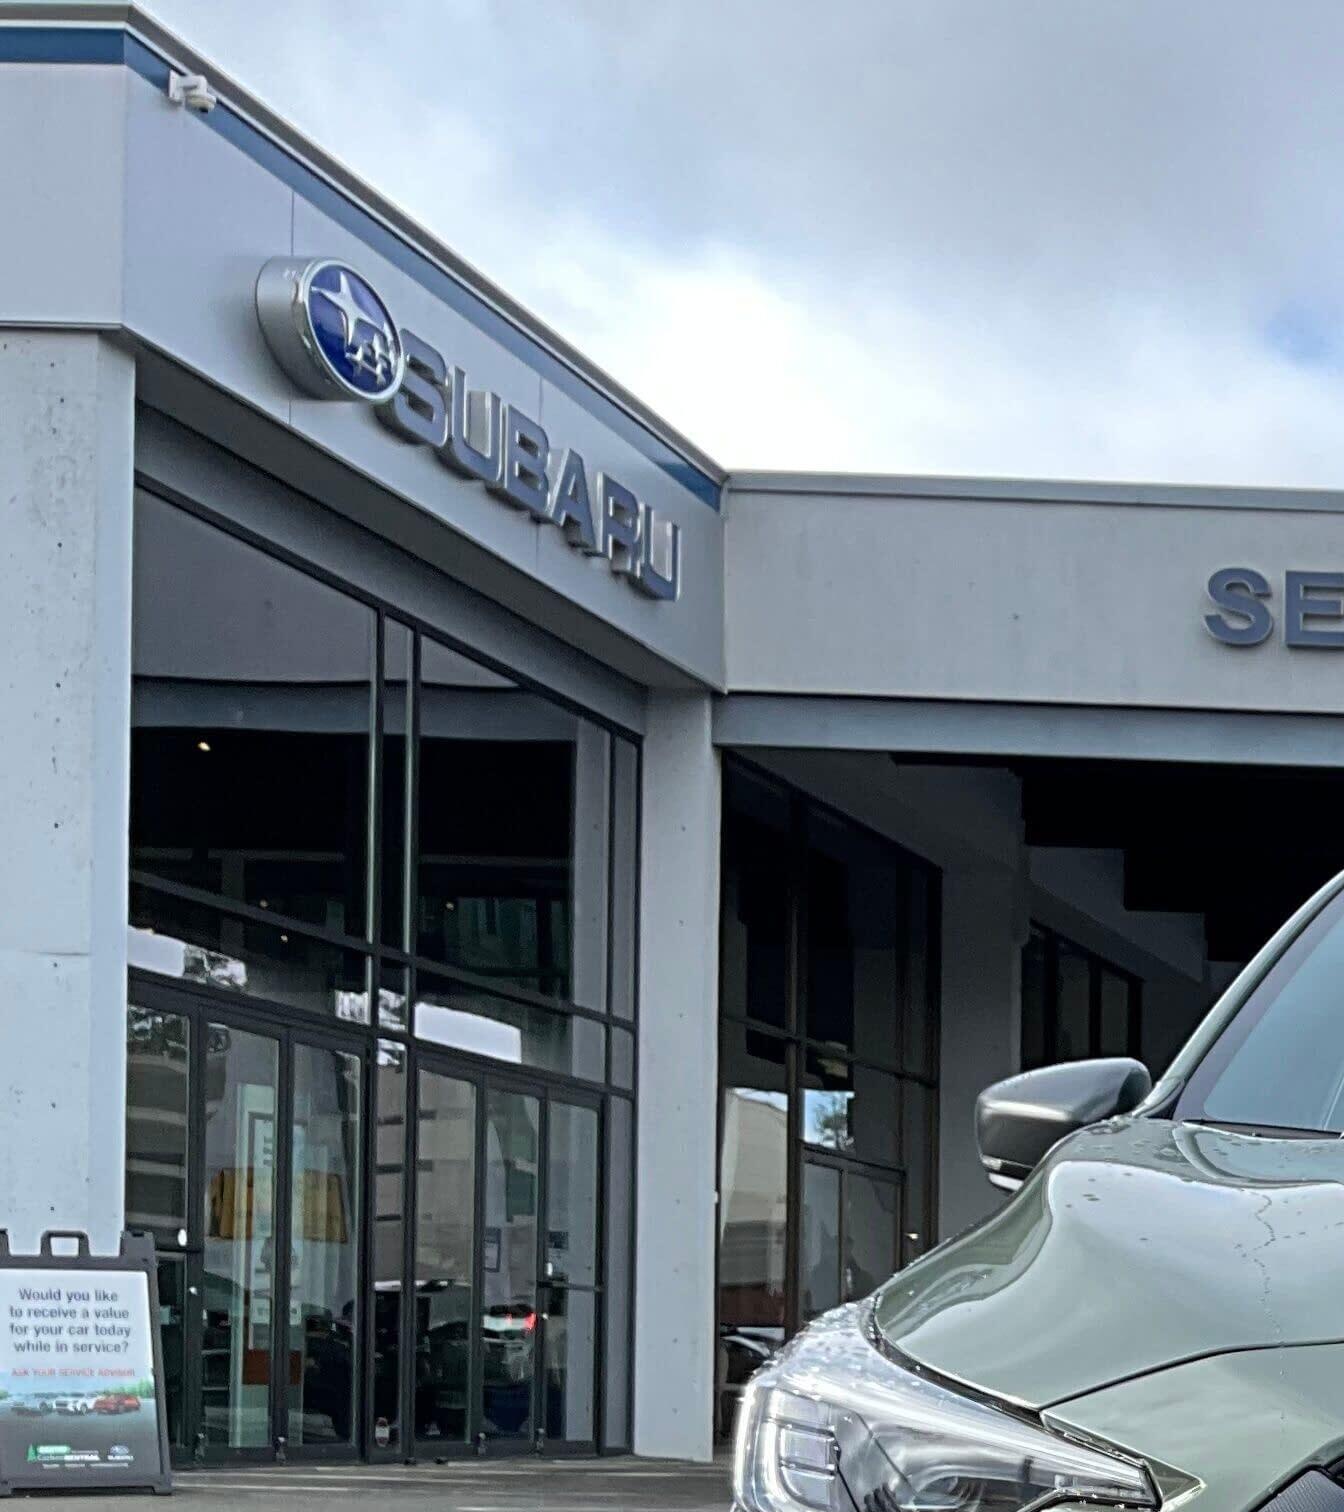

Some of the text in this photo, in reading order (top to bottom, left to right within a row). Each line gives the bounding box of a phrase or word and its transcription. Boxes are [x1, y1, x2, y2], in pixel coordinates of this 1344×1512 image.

[393, 327, 681, 601] SUBARU
[18, 1288, 119, 1303] Would you like
[9, 1305, 130, 1319] to receive a value
[9, 1322, 131, 1339] for your car today
[13, 1340, 129, 1353] while in service?
